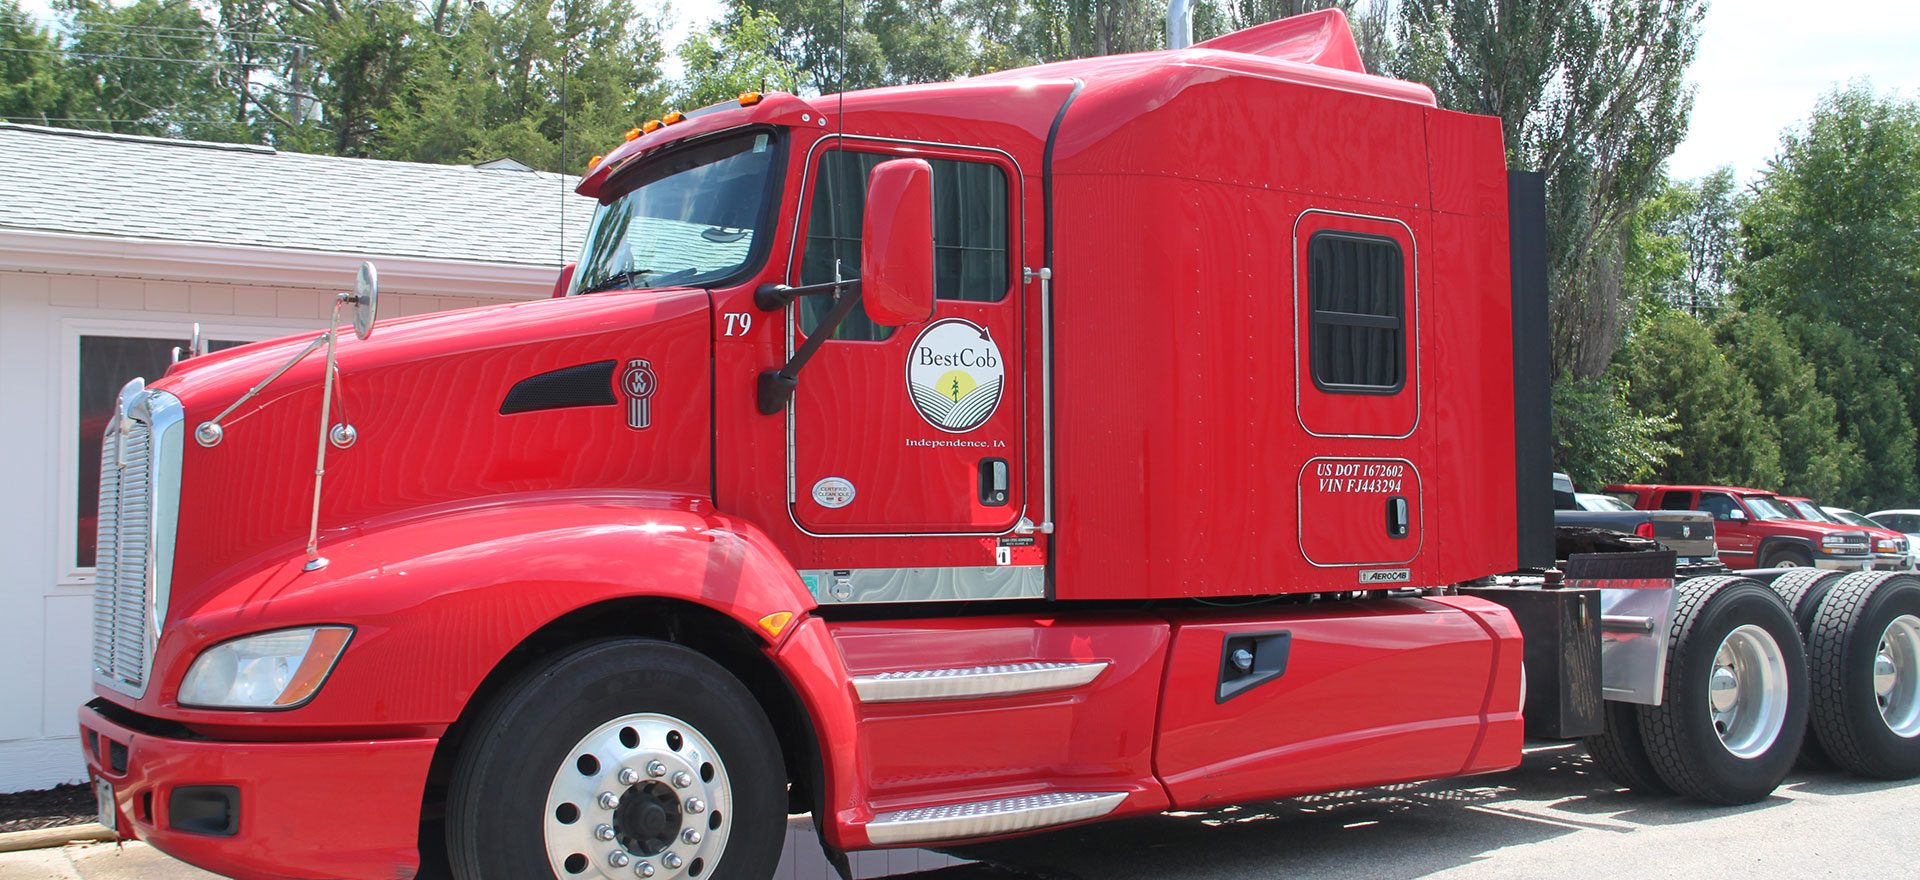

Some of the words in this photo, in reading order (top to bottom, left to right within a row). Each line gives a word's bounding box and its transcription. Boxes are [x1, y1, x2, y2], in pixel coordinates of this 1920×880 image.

[723, 312, 752, 337] T9
[919, 345, 997, 368] BestCob
[634, 371, 645, 383] K
[631, 382, 647, 393] W
[993, 440, 1006, 448] IA
[1317, 463, 1333, 476] US
[1335, 463, 1360, 476] DOT
[1363, 464, 1404, 477] 1672602
[1320, 478, 1343, 492] VIN
[1346, 478, 1402, 493] FJ443294
